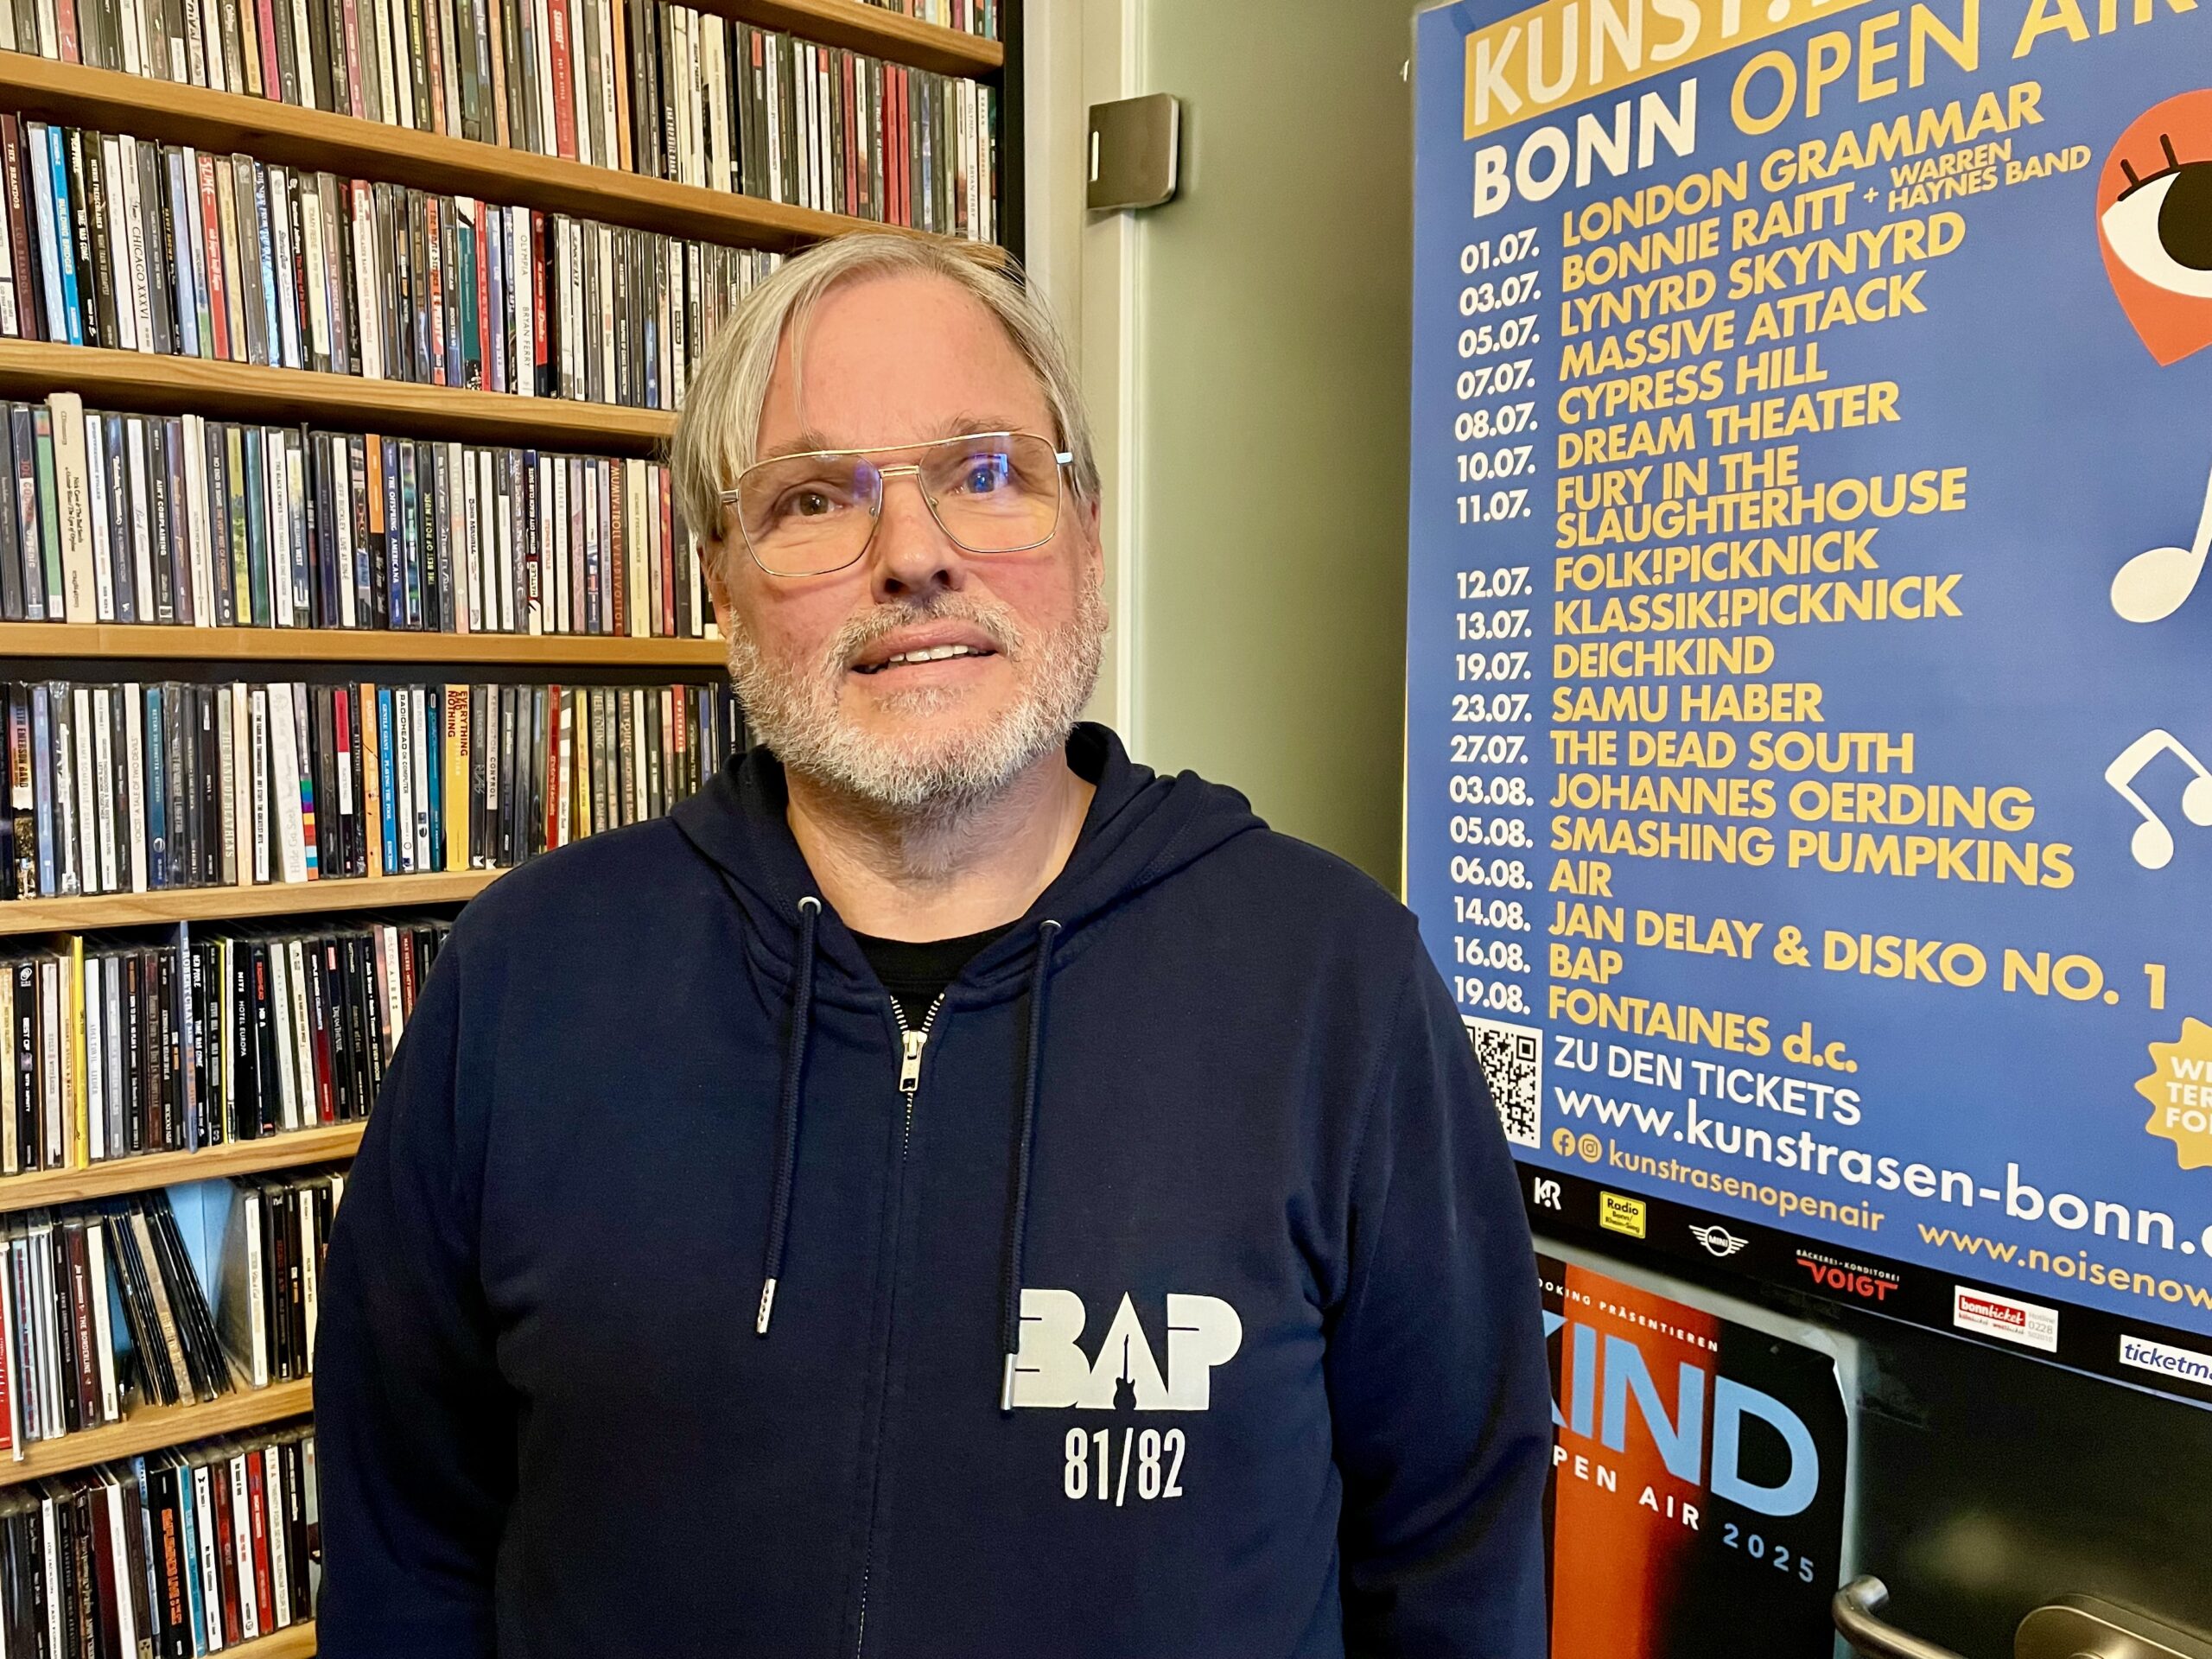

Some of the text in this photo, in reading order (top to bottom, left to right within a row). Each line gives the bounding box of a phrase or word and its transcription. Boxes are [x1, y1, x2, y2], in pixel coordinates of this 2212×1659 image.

[1473, 78, 1696, 218] BONN
[1731, 0, 1980, 135] OPEN
[9, 166, 20, 209] BRANDOS
[1461, 81, 2044, 274] 01.07. LONDON GRAMMAR
[1888, 145, 2091, 213] HAYNES BAND
[1891, 138, 2012, 188] WARREN
[58, 198, 73, 275] BUILDING BRIDGES
[1459, 270, 1541, 316] 03.07.
[1562, 217, 1719, 292] BONNIE
[1732, 181, 1855, 251] RAITT
[132, 226, 149, 320] CHICAGO XXXVI
[1459, 212, 1966, 358] 05.07. LYNYRD SKYNYRD
[522, 307, 531, 336] BRYAN
[1457, 270, 1928, 400] 07.07. MASSIVE ATTACK
[1455, 342, 1827, 442] 08.07. CYPRESS HILL
[1458, 381, 1901, 482] 10.07. DREAM THEATER
[389, 492, 397, 531] OFFSPRING
[1457, 445, 1798, 524] 11.07. FURY IN THE
[1555, 467, 1967, 549] SLAUGHTERHOUSE
[157, 501, 167, 556] COMPLAINING
[427, 540, 434, 551] OF
[1457, 528, 1879, 599] 12.07. FOLK!PICKNICK
[1457, 574, 1963, 639] 13.07. KLASSIK!PICKNICK
[1456, 636, 1775, 681] 19.07. DEICHKIND
[1452, 683, 1825, 722] 23.07. SAMU HABER
[17, 728, 29, 787] EMERSON BAND
[223, 754, 232, 782] BAND
[1451, 730, 1914, 773] 27.07. THE DEAD SOUTH
[225, 787, 233, 798] OF
[1450, 773, 2035, 831] 03.08. JOHANNES OERDING
[225, 804, 235, 858] HEATHENS
[1450, 816, 2075, 888] 05.08. SMASHING PUMPKINS
[1451, 856, 1613, 897] 06.08. AIR
[1454, 896, 2165, 1009] 14.08. JAN DELAY & DISKO NO. 1
[1454, 937, 1623, 984] 16.08. BAP
[182, 951, 193, 1024] ROBERT CRAY
[1455, 976, 1857, 1072] 19.08. FONTAINES d.c.
[1554, 1036, 1860, 1125] ZU DEN TICKETS
[2166, 1107, 2212, 1135] FO
[1555, 1088, 2212, 1257] www.kunstrasen-bonn.
[1610, 1139, 1885, 1230] kunstrasenopenair
[1607, 1198, 1639, 1216] Radio
[1708, 1235, 1729, 1248] MINI
[1796, 1259, 1898, 1300] VOIGT
[1599, 1301, 1718, 1352] PRÄSENTIEREN
[1961, 1296, 2024, 1325] bonnticket
[2028, 1320, 2053, 1335] 0228
[80, 1331, 91, 1374] BORDERLINE
[1014, 1287, 1243, 1411] BAP
[1064, 1427, 1185, 1507] 81/82
[1638, 1485, 1700, 1530] AIR
[1722, 1522, 1814, 1583] 2025
